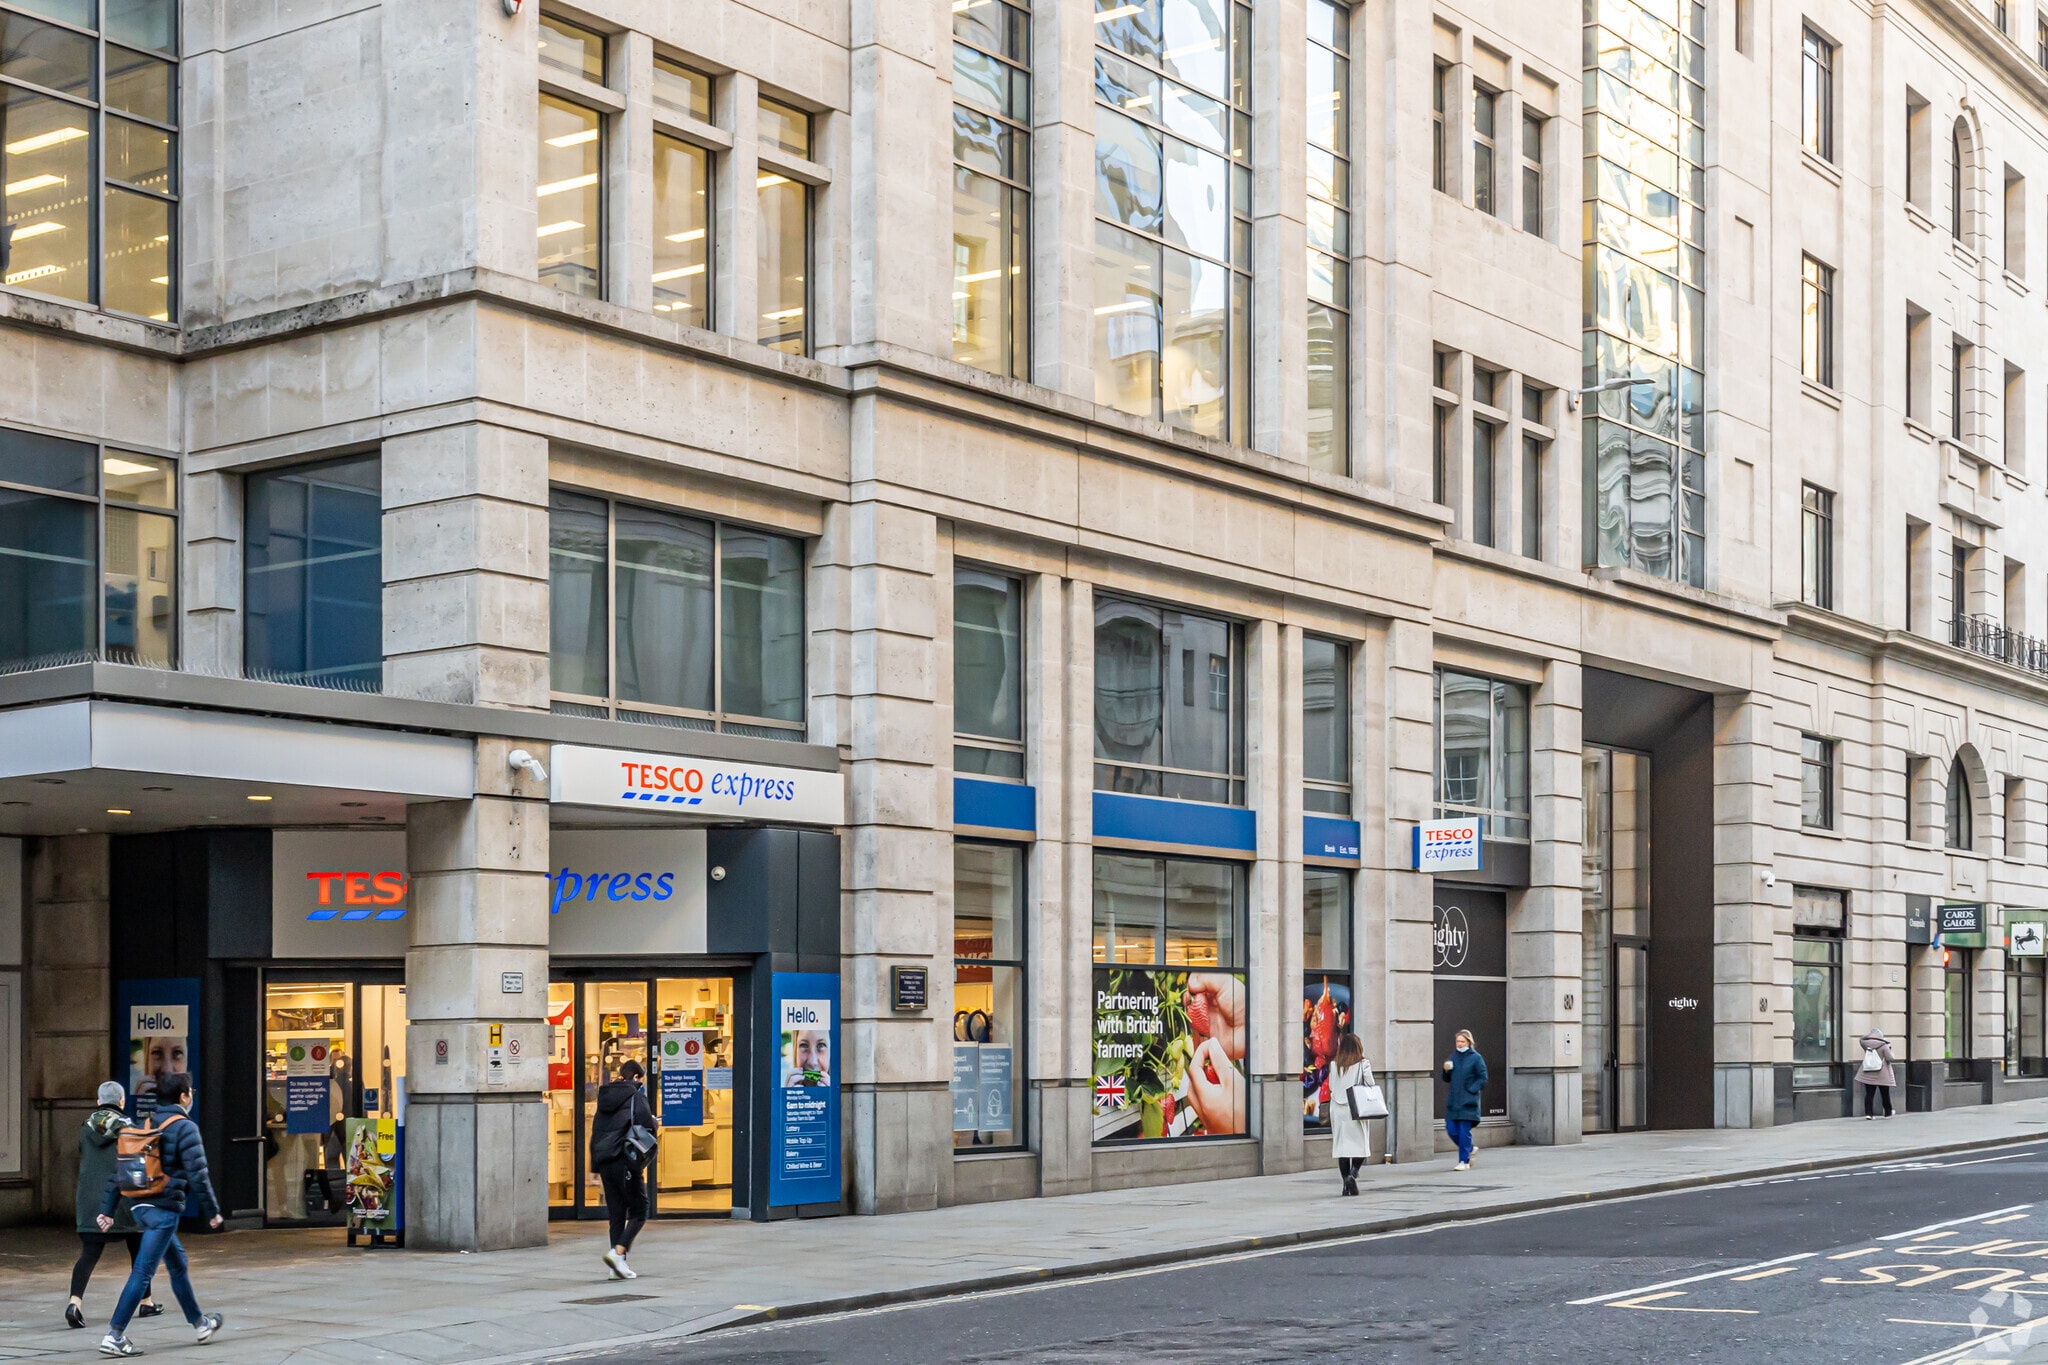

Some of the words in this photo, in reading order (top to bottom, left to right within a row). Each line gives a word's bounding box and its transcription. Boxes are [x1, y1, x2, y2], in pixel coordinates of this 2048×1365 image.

[621, 762, 703, 793] TESCO
[711, 771, 795, 806] express
[1425, 828, 1473, 841] TESCO
[1324, 844, 1336, 853] Bank
[1424, 847, 1473, 862] express
[306, 871, 408, 905] TES
[544, 867, 675, 915] press
[1943, 918, 1977, 928] GALORE
[1945, 910, 1974, 919] CARDS
[1433, 923, 1466, 954] ighty
[1097, 990, 1159, 1015] Partnering
[1668, 997, 1699, 1010] eighty
[137, 1012, 175, 1030] Hello.
[787, 1006, 820, 1024] Hello.
[1097, 1015, 1123, 1034] with
[1126, 1015, 1164, 1034] British
[490, 1026, 502, 1044] H
[1097, 1039, 1144, 1059] farmers
[786, 1101, 798, 1110] 6am
[804, 1101, 827, 1110] midnight
[378, 1131, 394, 1141] Free
[786, 1125, 800, 1133] Lottery
